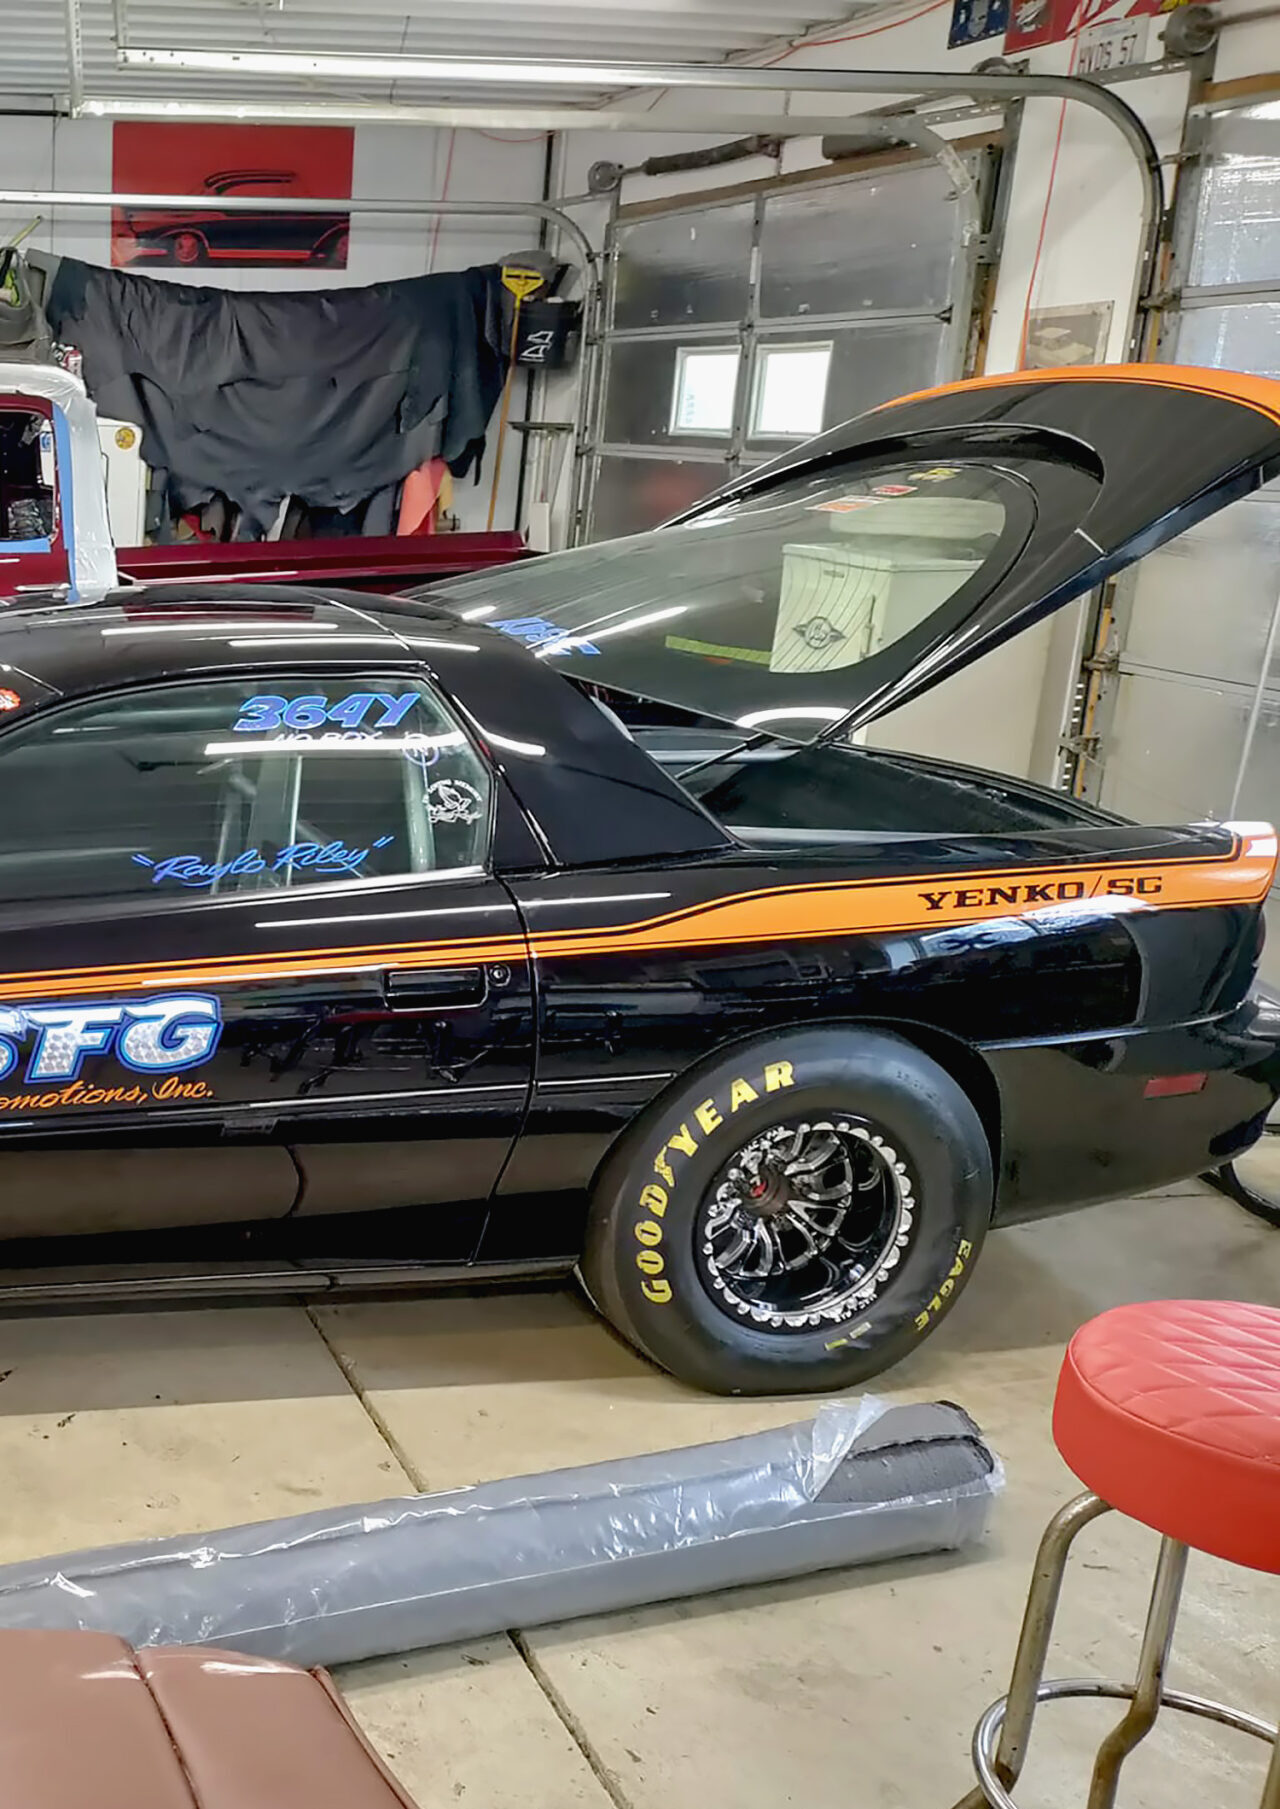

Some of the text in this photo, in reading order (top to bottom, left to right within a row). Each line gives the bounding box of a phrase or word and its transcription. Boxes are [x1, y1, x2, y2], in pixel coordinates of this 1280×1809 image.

[233, 692, 421, 732] 364Y
[152, 1076, 214, 1100] Inc.
[634, 1060, 795, 1304] GOODYEAR
[914, 1239, 972, 1331] EAGLE
